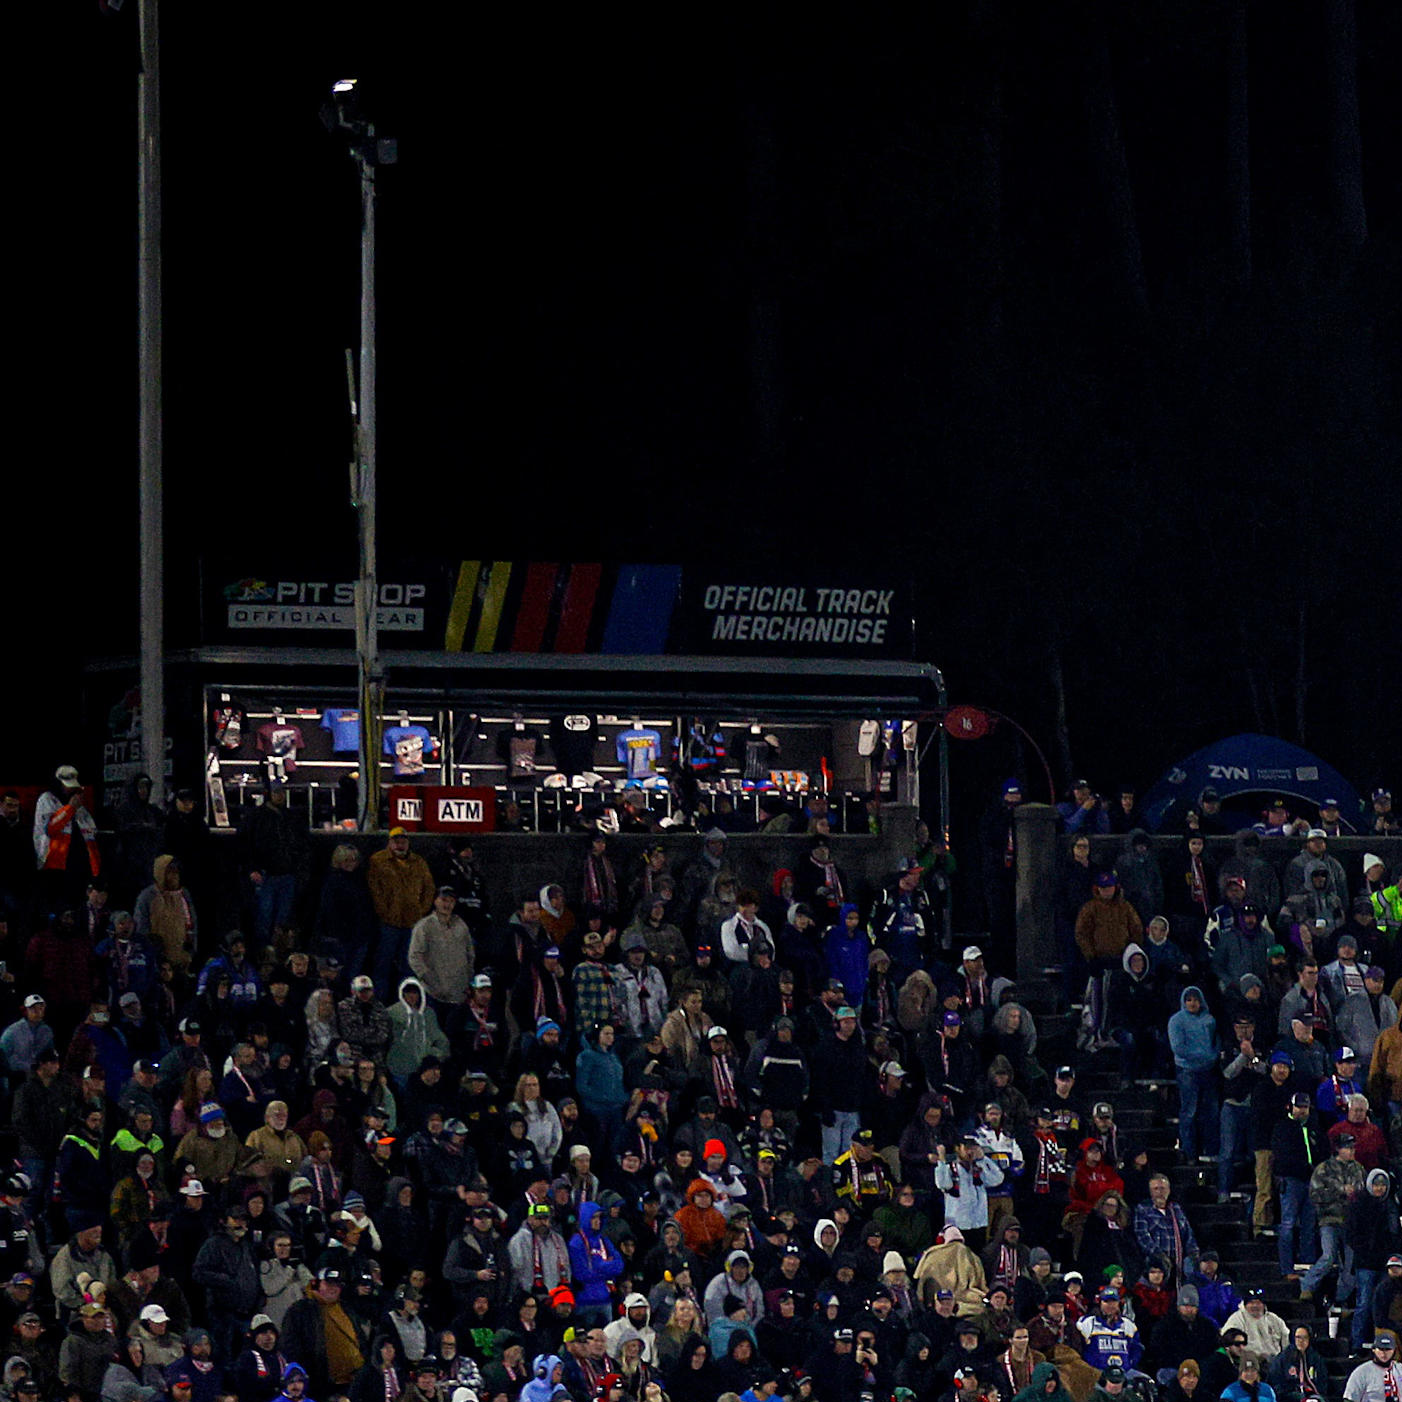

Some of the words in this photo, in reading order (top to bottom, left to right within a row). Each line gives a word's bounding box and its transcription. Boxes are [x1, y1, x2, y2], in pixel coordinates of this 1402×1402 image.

[277, 582, 328, 602] PIT
[334, 584, 426, 605] SOP
[704, 585, 808, 612] OFFICIAL
[816, 588, 894, 614] TRACK
[235, 610, 341, 623] OFFICIAL
[367, 612, 417, 624] EAR
[712, 615, 888, 643] MERCHANDISE
[1208, 765, 1249, 780] ZYN
[441, 802, 480, 819] ATM
